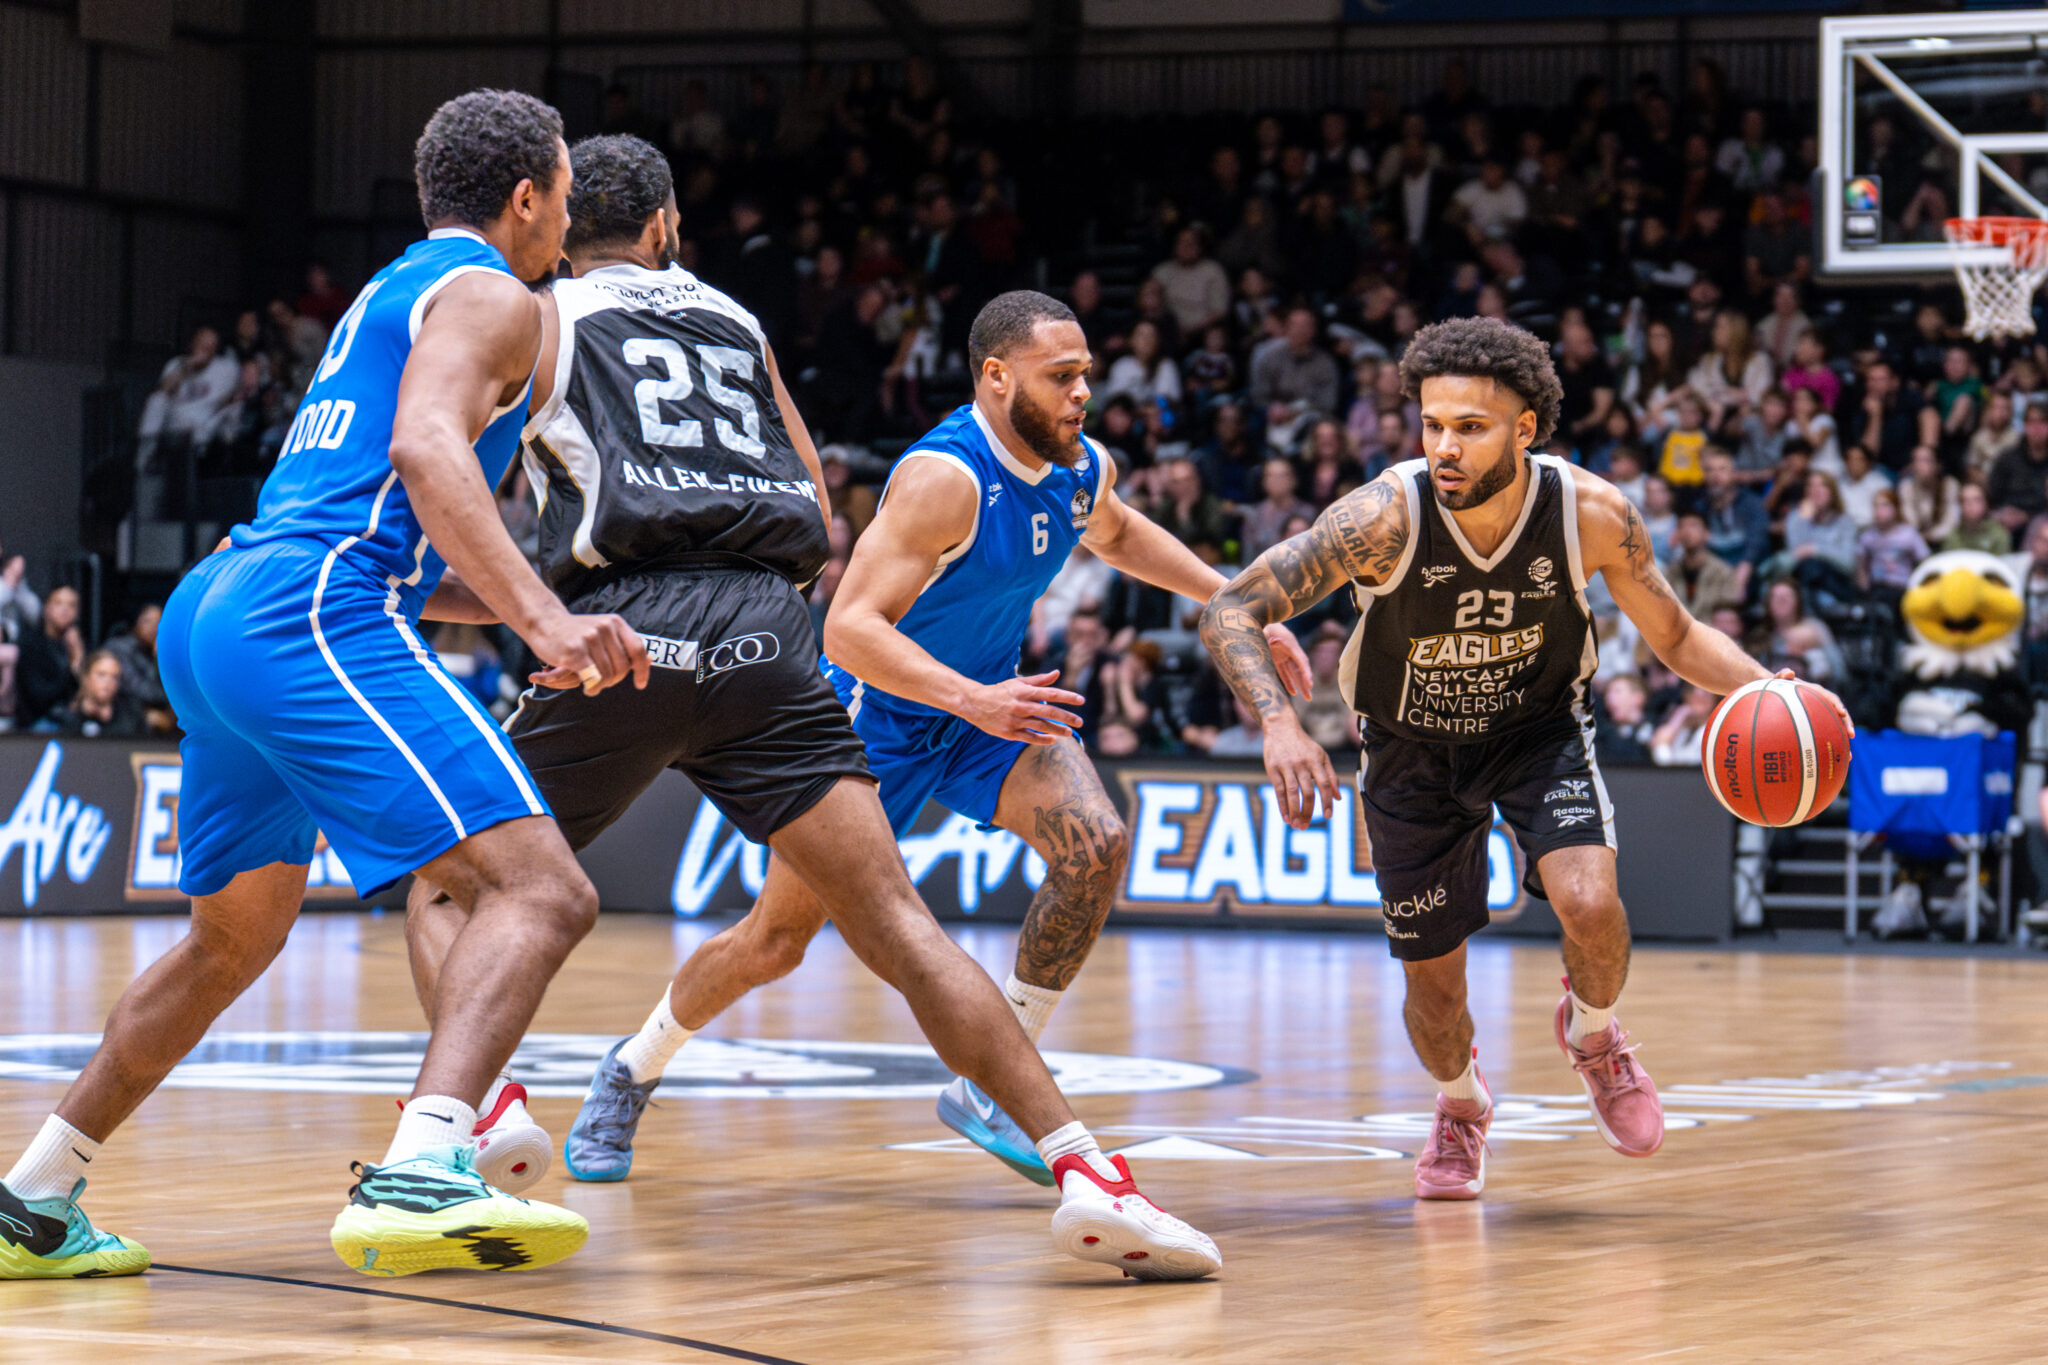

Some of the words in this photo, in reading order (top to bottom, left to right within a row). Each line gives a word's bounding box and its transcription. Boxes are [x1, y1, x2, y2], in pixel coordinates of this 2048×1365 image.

[622, 337, 767, 459] 25
[1031, 512, 1049, 556] 6
[1335, 511, 1382, 566] CLARK
[1455, 589, 1515, 629] 23
[709, 636, 764, 671] CO
[1411, 623, 1543, 666] EAGLES
[1413, 652, 1539, 682] NEWCASTLE
[1411, 687, 1526, 714] UNIVERSITY
[1407, 708, 1491, 735] CENTRE
[1723, 732, 1743, 799] molten
[1762, 751, 1780, 784] FIBA
[1543, 791, 1591, 804] EAGLES
[1552, 805, 1597, 818] Reebok
